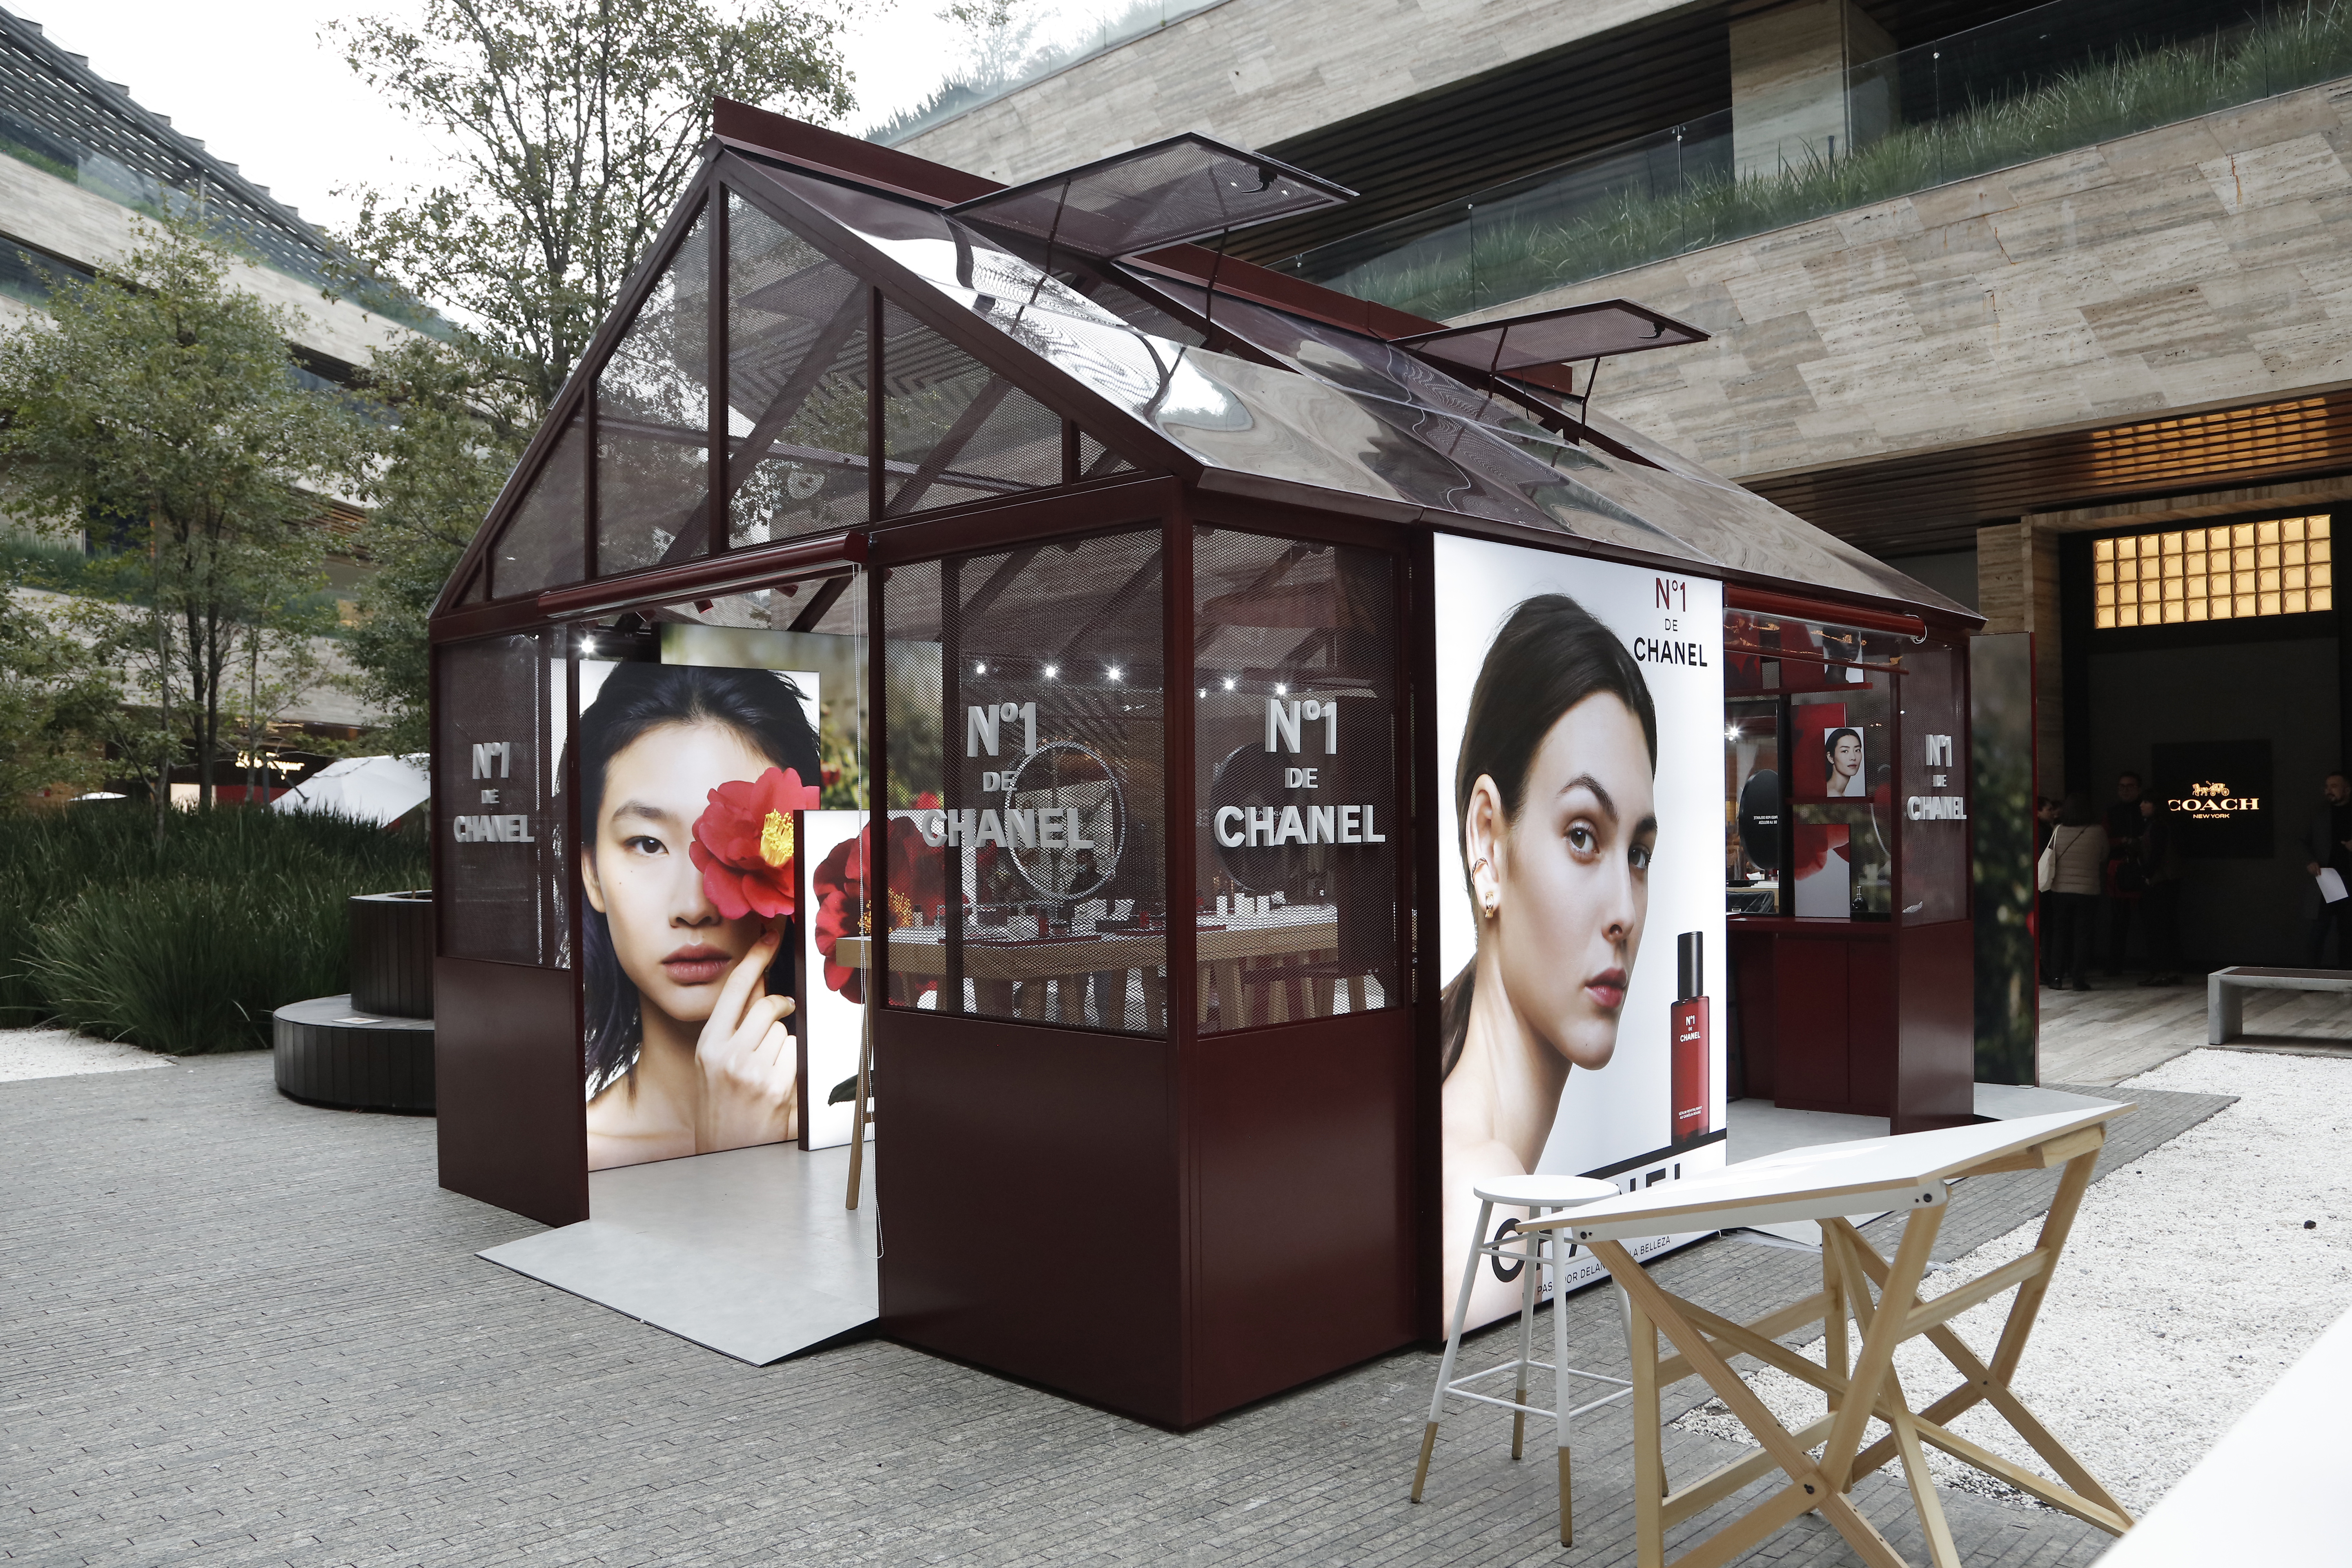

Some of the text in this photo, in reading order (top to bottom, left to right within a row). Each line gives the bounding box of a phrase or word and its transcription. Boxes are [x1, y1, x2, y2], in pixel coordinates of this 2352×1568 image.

[1665, 618, 1678, 632] DE
[1634, 637, 1708, 667] CHANEL
[982, 771, 1018, 792] DE
[1285, 768, 1318, 788] DE
[1933, 774, 1947, 787] DE
[481, 789, 500, 804] DE
[2167, 798, 2260, 811] COACH
[1907, 796, 1967, 821] CHANEL
[454, 815, 535, 843] CHANEL
[922, 808, 1094, 849] CHANEL
[1214, 804, 1386, 848] CHANEL
[1680, 1031, 1701, 1042] CHANEL
[1537, 1281, 1553, 1296] PAS
[1580, 1262, 1606, 1279] DELAN
[1640, 1235, 1671, 1255] BELLEZA
